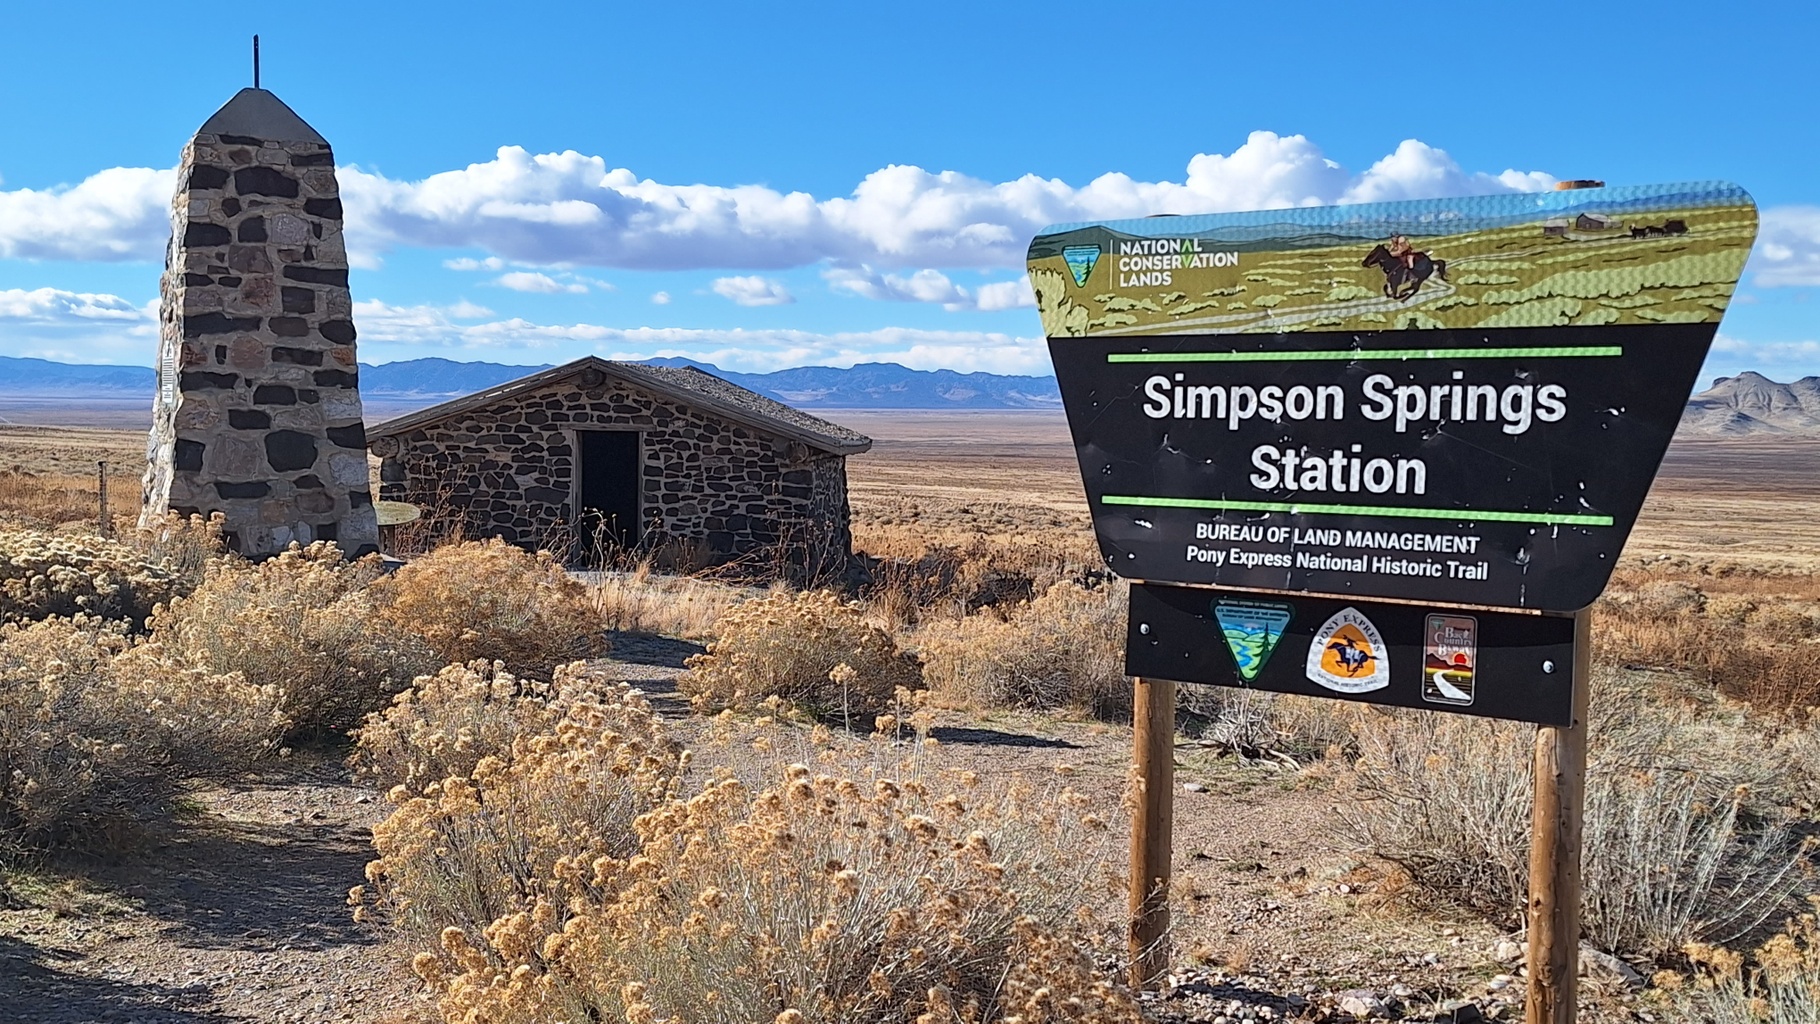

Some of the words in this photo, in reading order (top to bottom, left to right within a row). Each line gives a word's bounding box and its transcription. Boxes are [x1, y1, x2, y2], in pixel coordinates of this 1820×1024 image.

[1119, 238, 1203, 256] NATIONAL
[1119, 252, 1239, 272] CONSERVATION
[1119, 271, 1172, 288] LANDS
[1143, 373, 1344, 430] Simpson
[1360, 371, 1567, 434] Springs
[1250, 444, 1426, 495] Station
[1196, 523, 1263, 542] BUREAU
[1266, 526, 1291, 543] OF
[1293, 528, 1342, 547] LAND
[1345, 531, 1480, 553] MANAGEMENT
[1186, 545, 1227, 567] Pony
[1229, 549, 1292, 569] Express
[1295, 552, 1368, 573] National
[1371, 556, 1443, 577] Historic
[1446, 560, 1488, 580] Trail
[1316, 618, 1339, 646] PONY
[1343, 614, 1381, 652] EXPRESS
